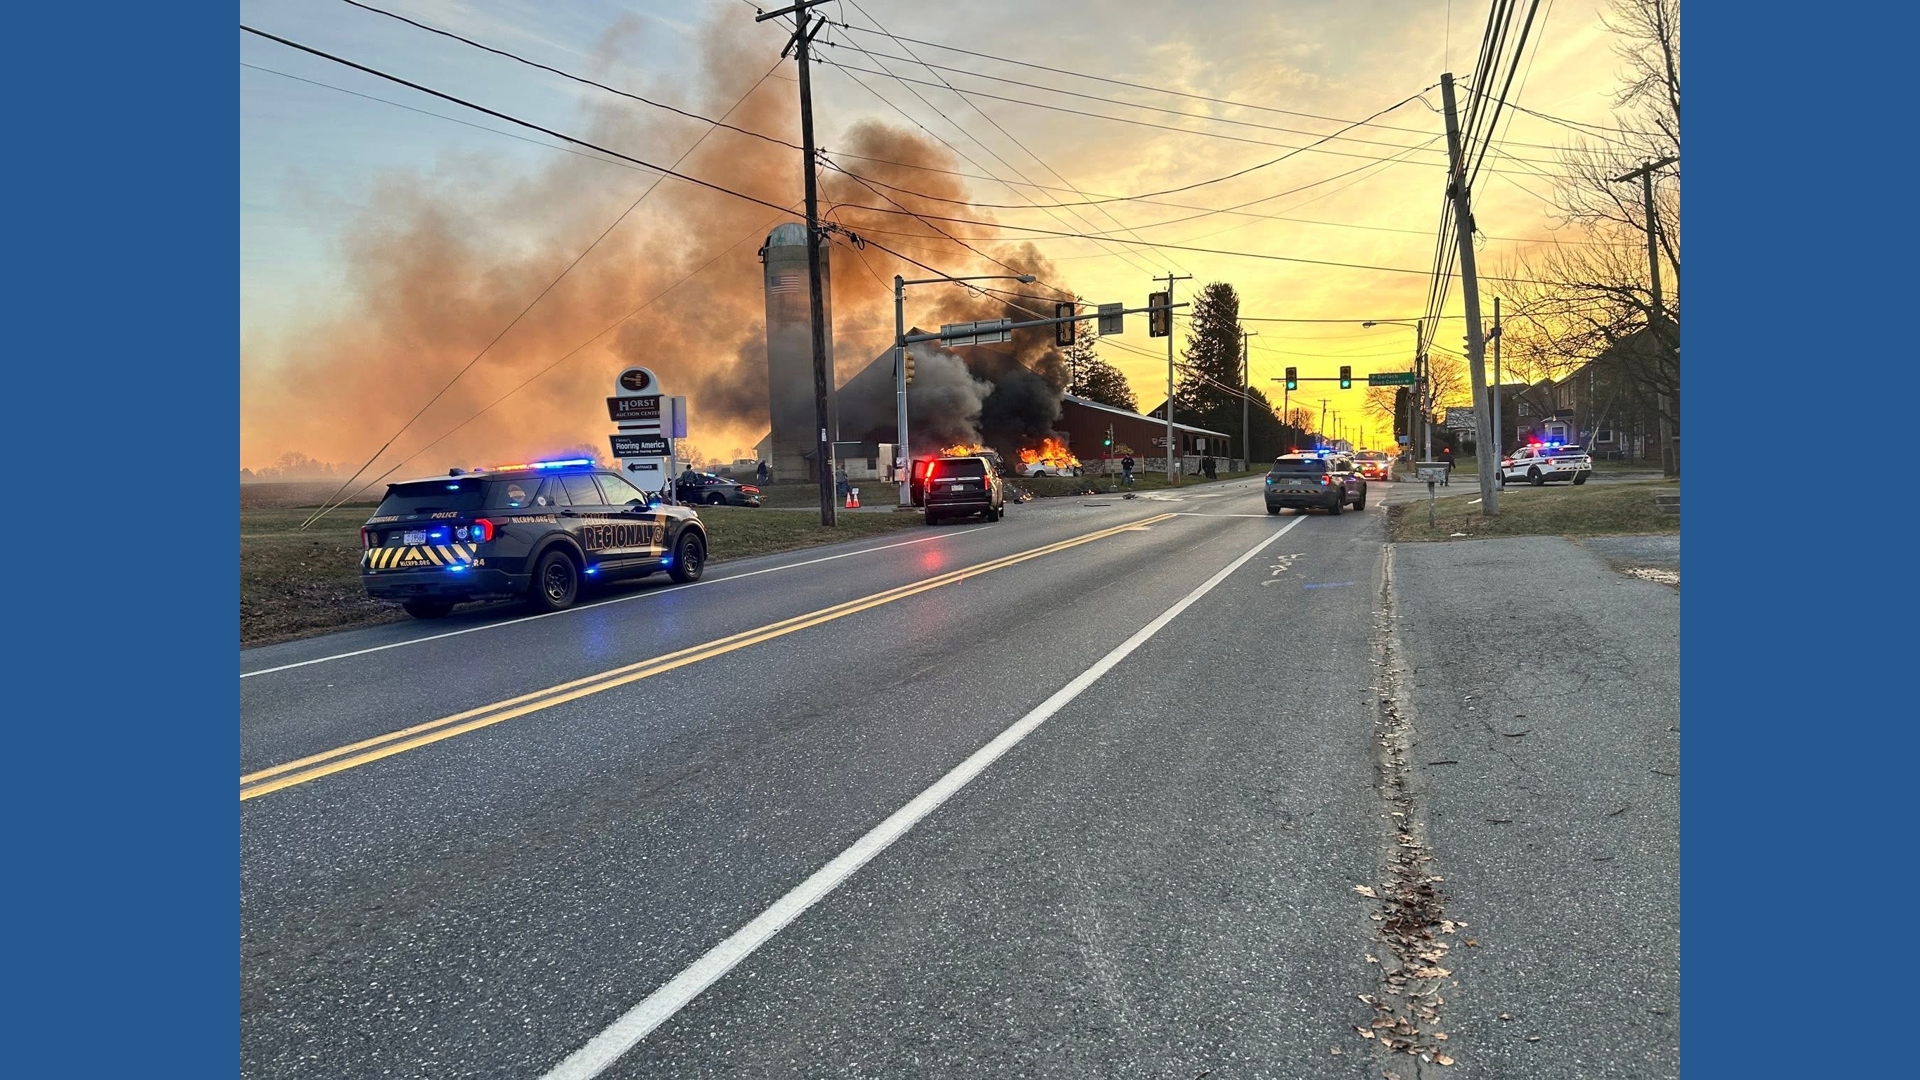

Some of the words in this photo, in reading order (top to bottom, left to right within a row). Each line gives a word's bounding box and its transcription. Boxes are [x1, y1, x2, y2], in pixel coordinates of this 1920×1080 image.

[618, 399, 655, 411] HORST
[616, 442, 640, 450] Flooring
[641, 440, 665, 449] America
[430, 511, 458, 519] POLICE
[511, 515, 548, 524] NLCRPD.ORG
[579, 512, 609, 525] POLICE
[583, 523, 650, 551] REGIONAL
[399, 559, 431, 567] NLCRPD.ORG
